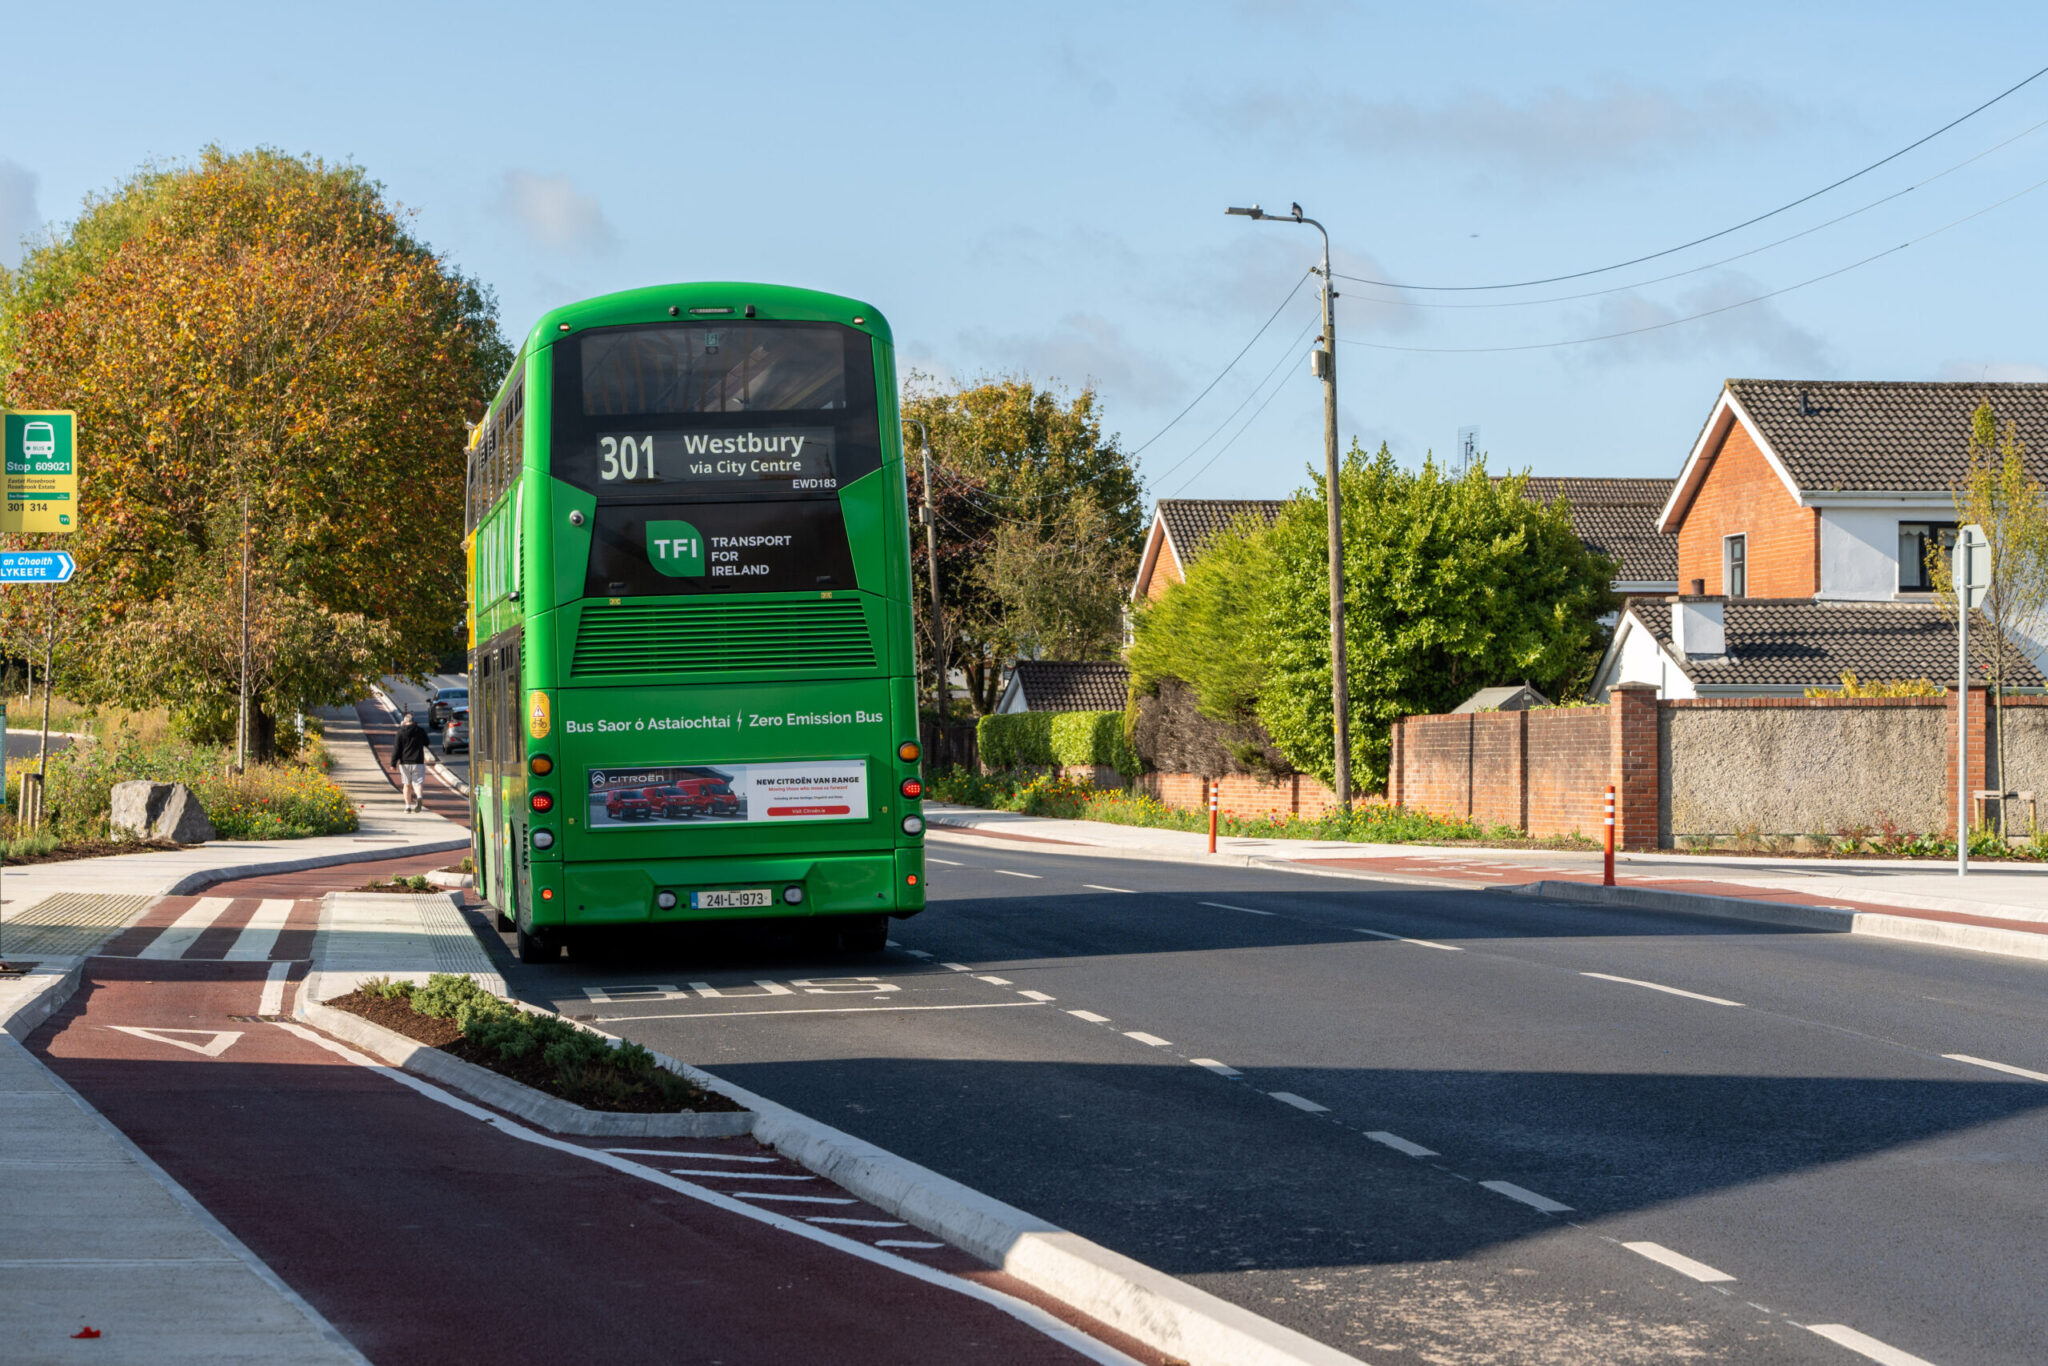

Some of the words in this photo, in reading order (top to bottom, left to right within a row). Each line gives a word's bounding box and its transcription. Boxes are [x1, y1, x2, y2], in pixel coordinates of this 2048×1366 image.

[600, 435, 655, 480] 301
[683, 432, 805, 457] Westbury
[7, 461, 31, 472] Stop
[35, 462, 70, 471] 609021
[689, 462, 713, 474] via
[716, 460, 747, 476] City
[750, 458, 802, 473] Centre
[792, 478, 837, 489] EWD183
[8, 503, 24, 511] 301
[30, 503, 47, 511] 314
[711, 535, 792, 547] TRANSPORT
[653, 538, 697, 559] TFI
[711, 551, 739, 562] FOR
[711, 564, 770, 576] IRELAND
[566, 720, 594, 733] Bus
[598, 719, 632, 732] Saor
[634, 718, 645, 731] ó
[749, 713, 783, 727] Zero
[787, 711, 852, 726] Emission
[855, 710, 884, 723] Bus
[609, 774, 665, 783] CITROËN
[776, 776, 812, 785] CITROËN
[707, 892, 764, 907] 241-L-1973
[582, 976, 901, 1003] BUS
